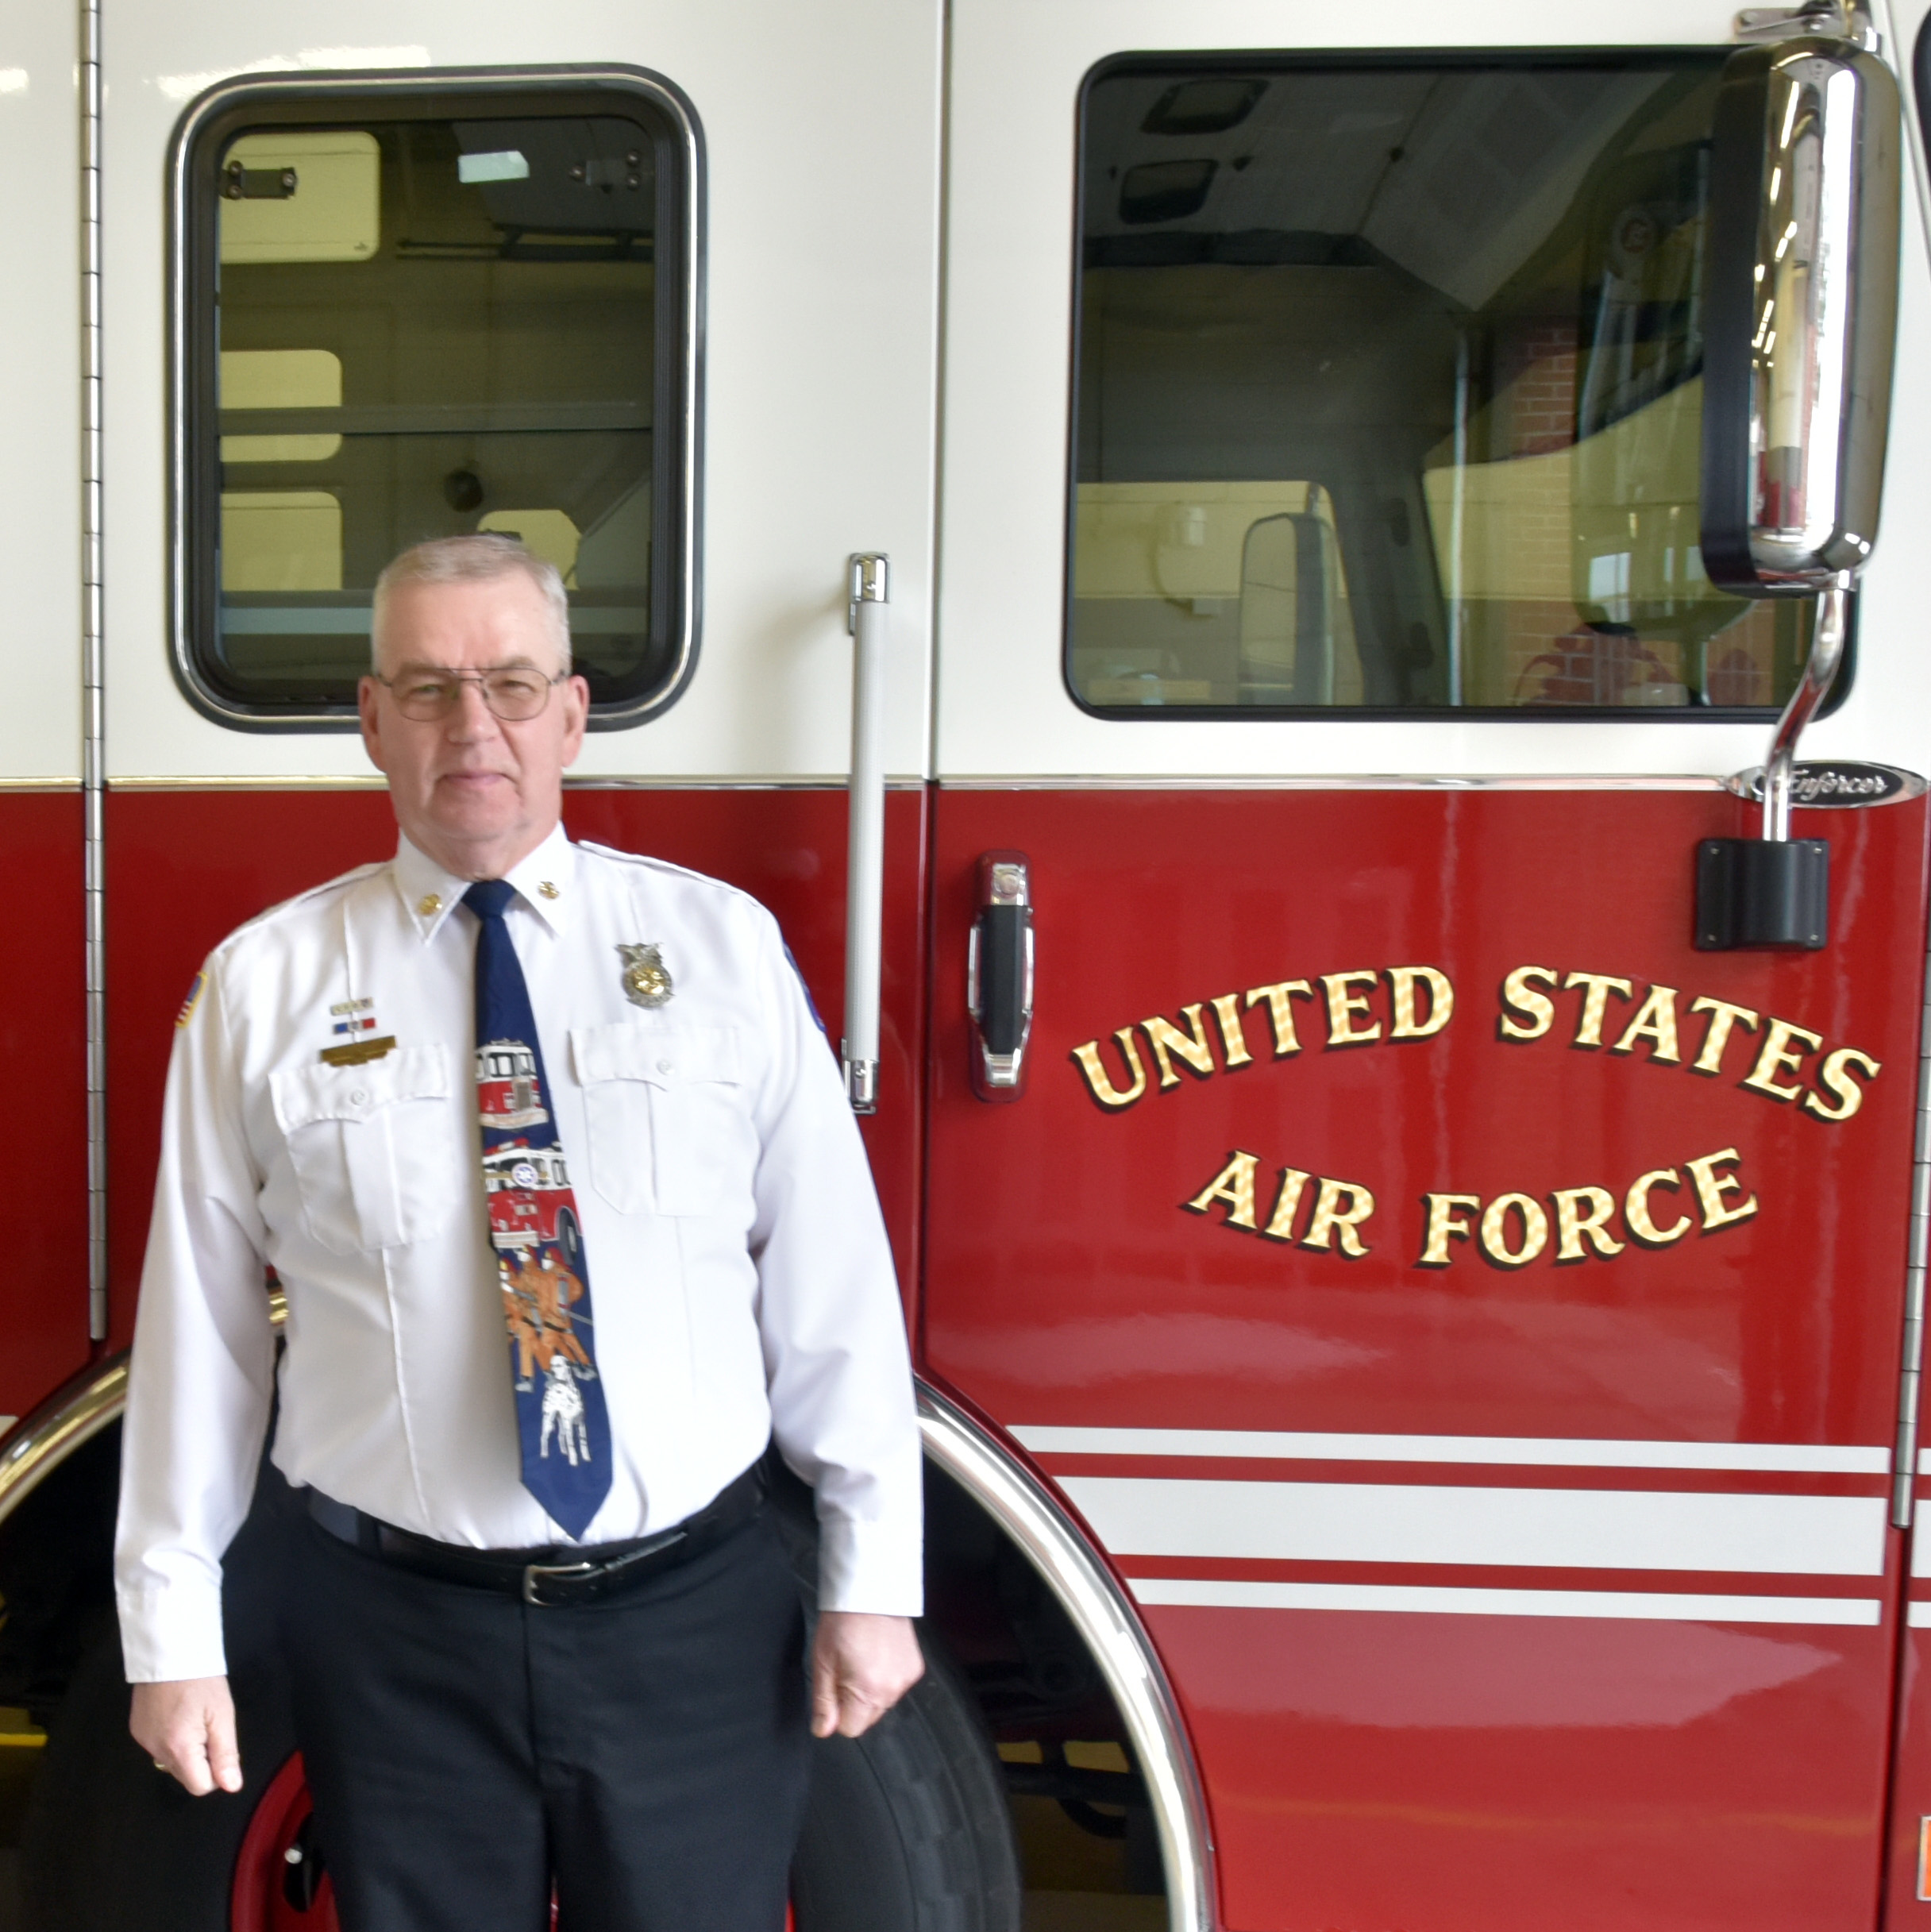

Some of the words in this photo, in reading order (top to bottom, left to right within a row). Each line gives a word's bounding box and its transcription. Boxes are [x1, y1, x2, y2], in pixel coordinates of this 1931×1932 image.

[1072, 965, 1454, 1112] UNITED
[1497, 965, 1881, 1121] STATES
[1182, 1150, 1374, 1258] AIR
[1416, 1147, 1758, 1269] FORCE
